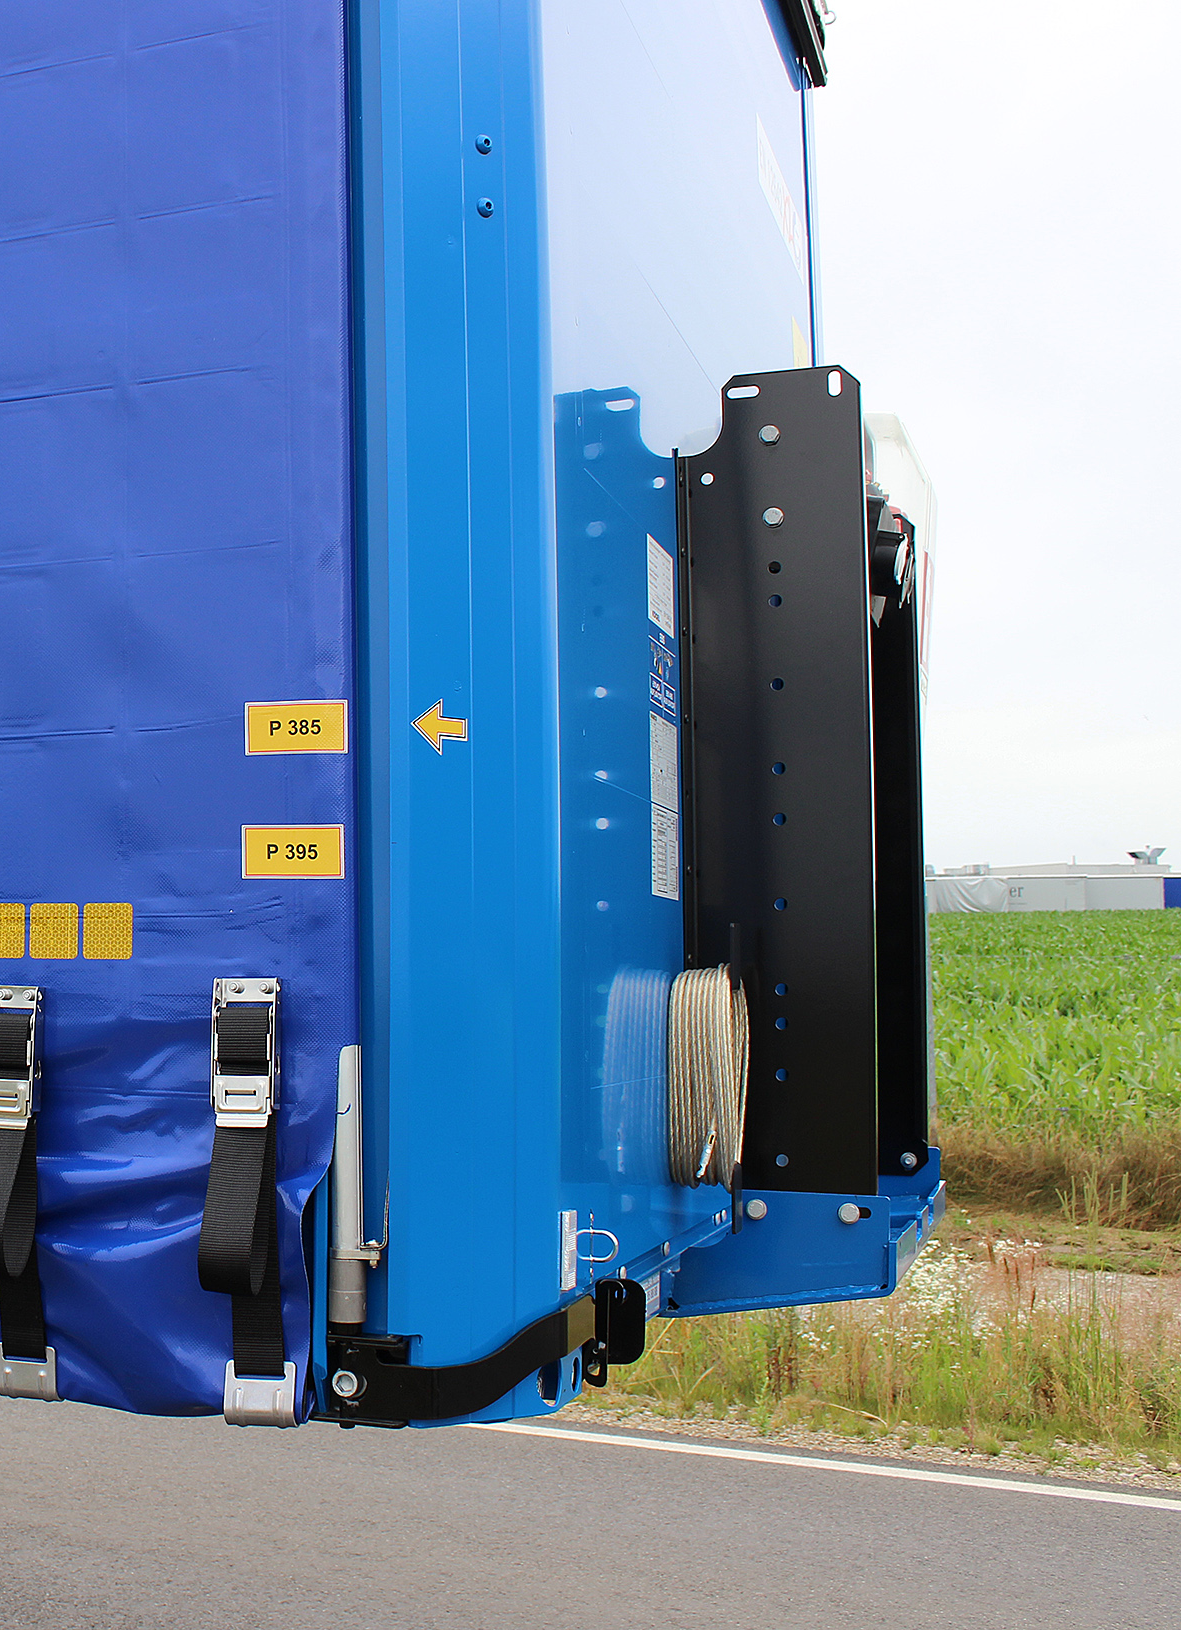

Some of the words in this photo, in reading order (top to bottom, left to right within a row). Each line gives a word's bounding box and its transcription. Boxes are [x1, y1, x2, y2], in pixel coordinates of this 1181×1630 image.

[269, 720, 282, 736] P
[288, 719, 321, 736] 385
[266, 844, 279, 860] P
[285, 843, 318, 860] 395
